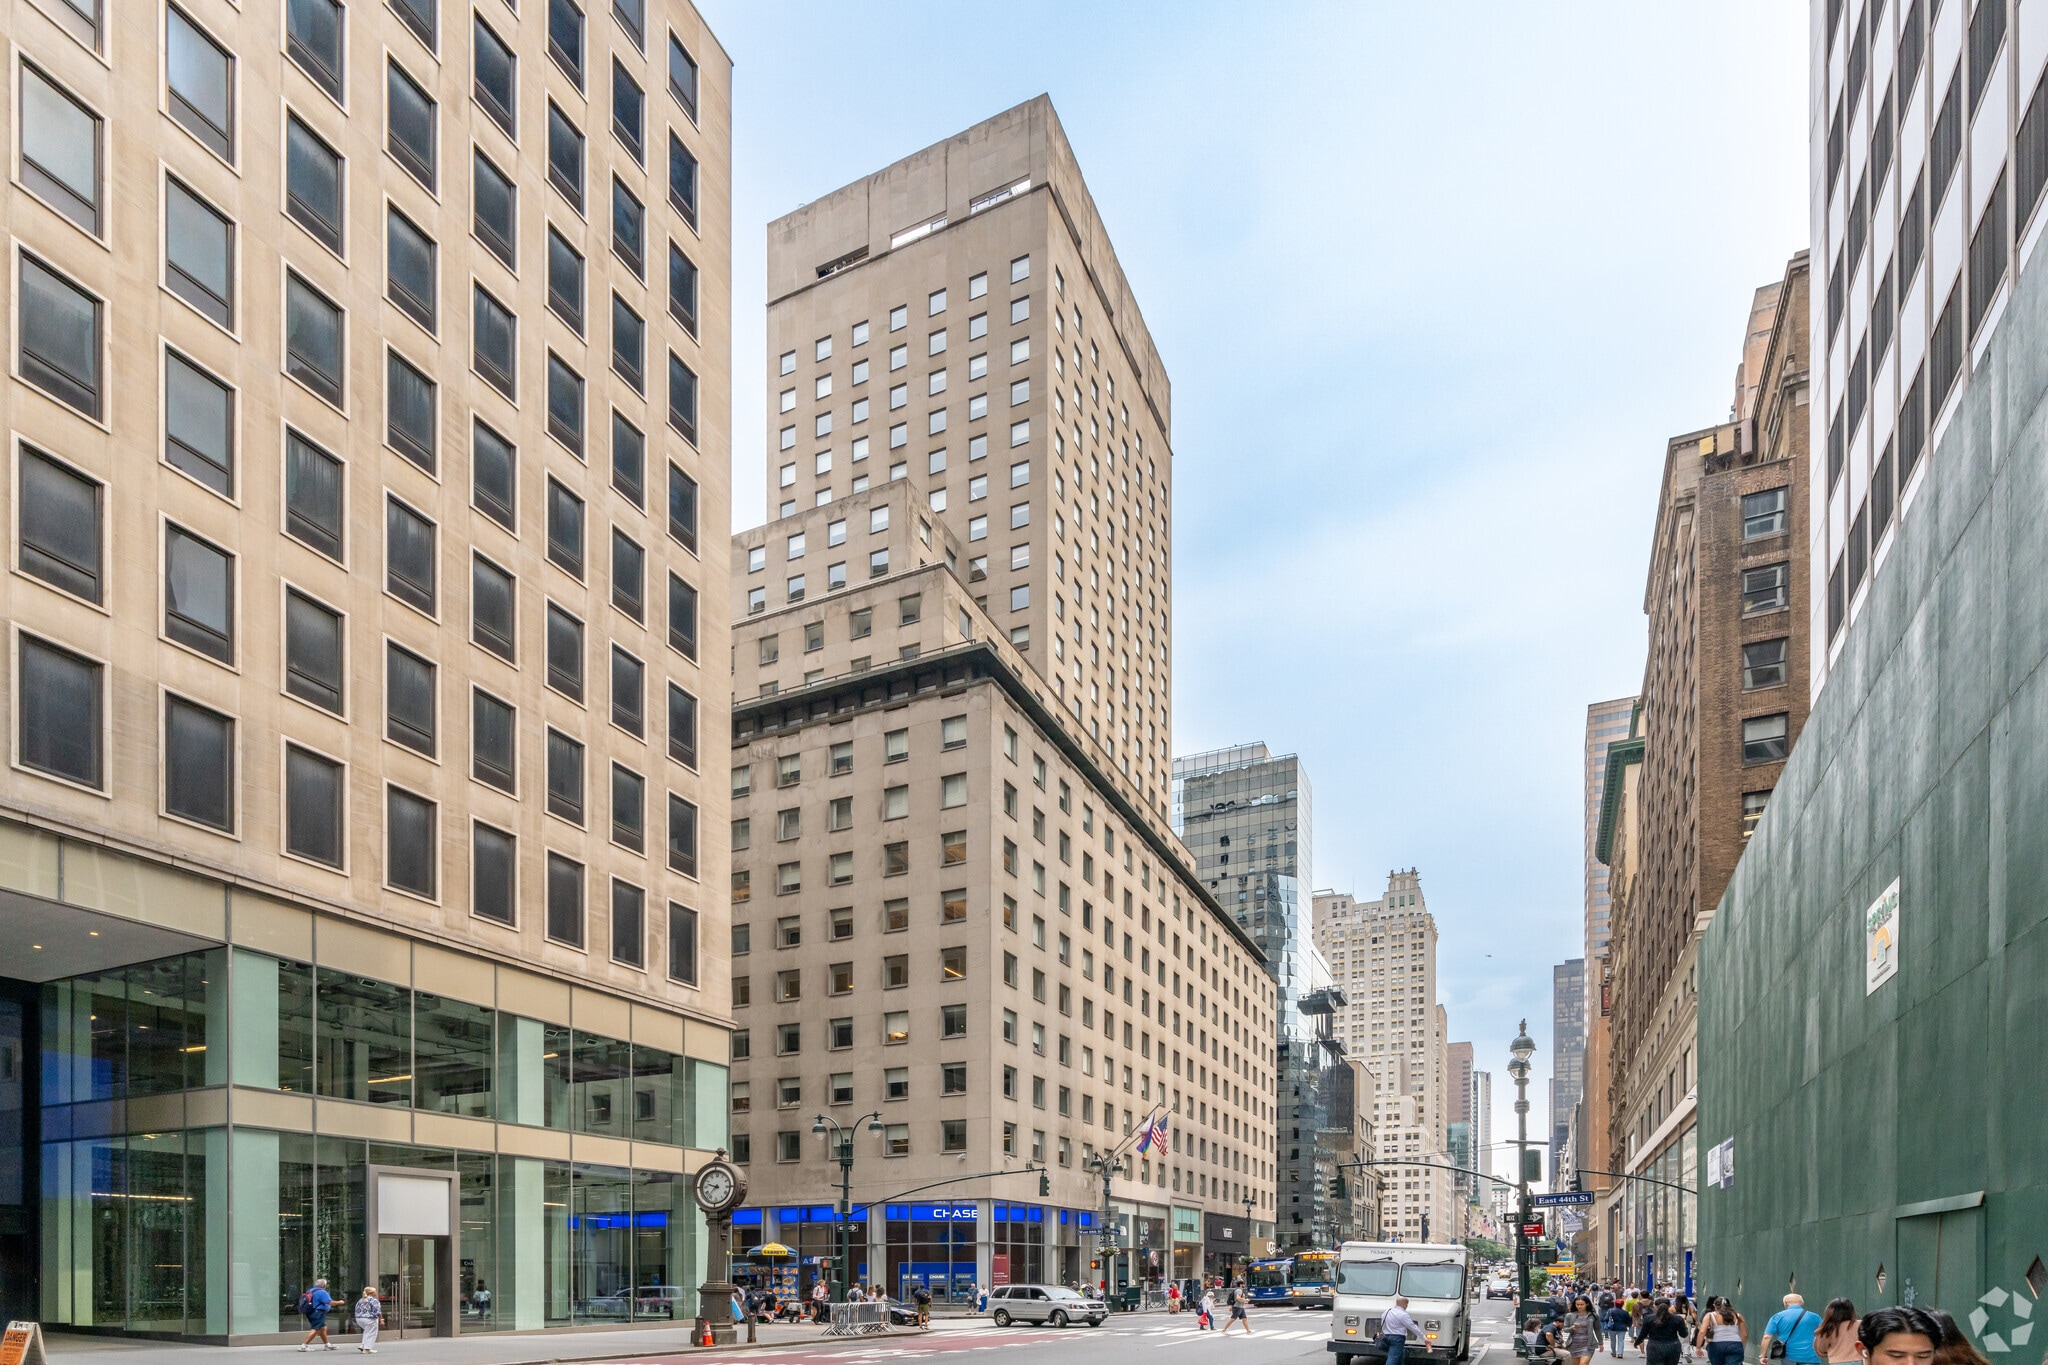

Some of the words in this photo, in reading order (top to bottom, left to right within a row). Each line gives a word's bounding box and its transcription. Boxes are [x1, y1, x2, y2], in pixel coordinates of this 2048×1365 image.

[1538, 1196, 1557, 1204] East
[1559, 1195, 1577, 1203] 44th
[1580, 1194, 1589, 1202] St
[933, 1208, 978, 1218] CHASE
[4, 1331, 27, 1343] DANGER
